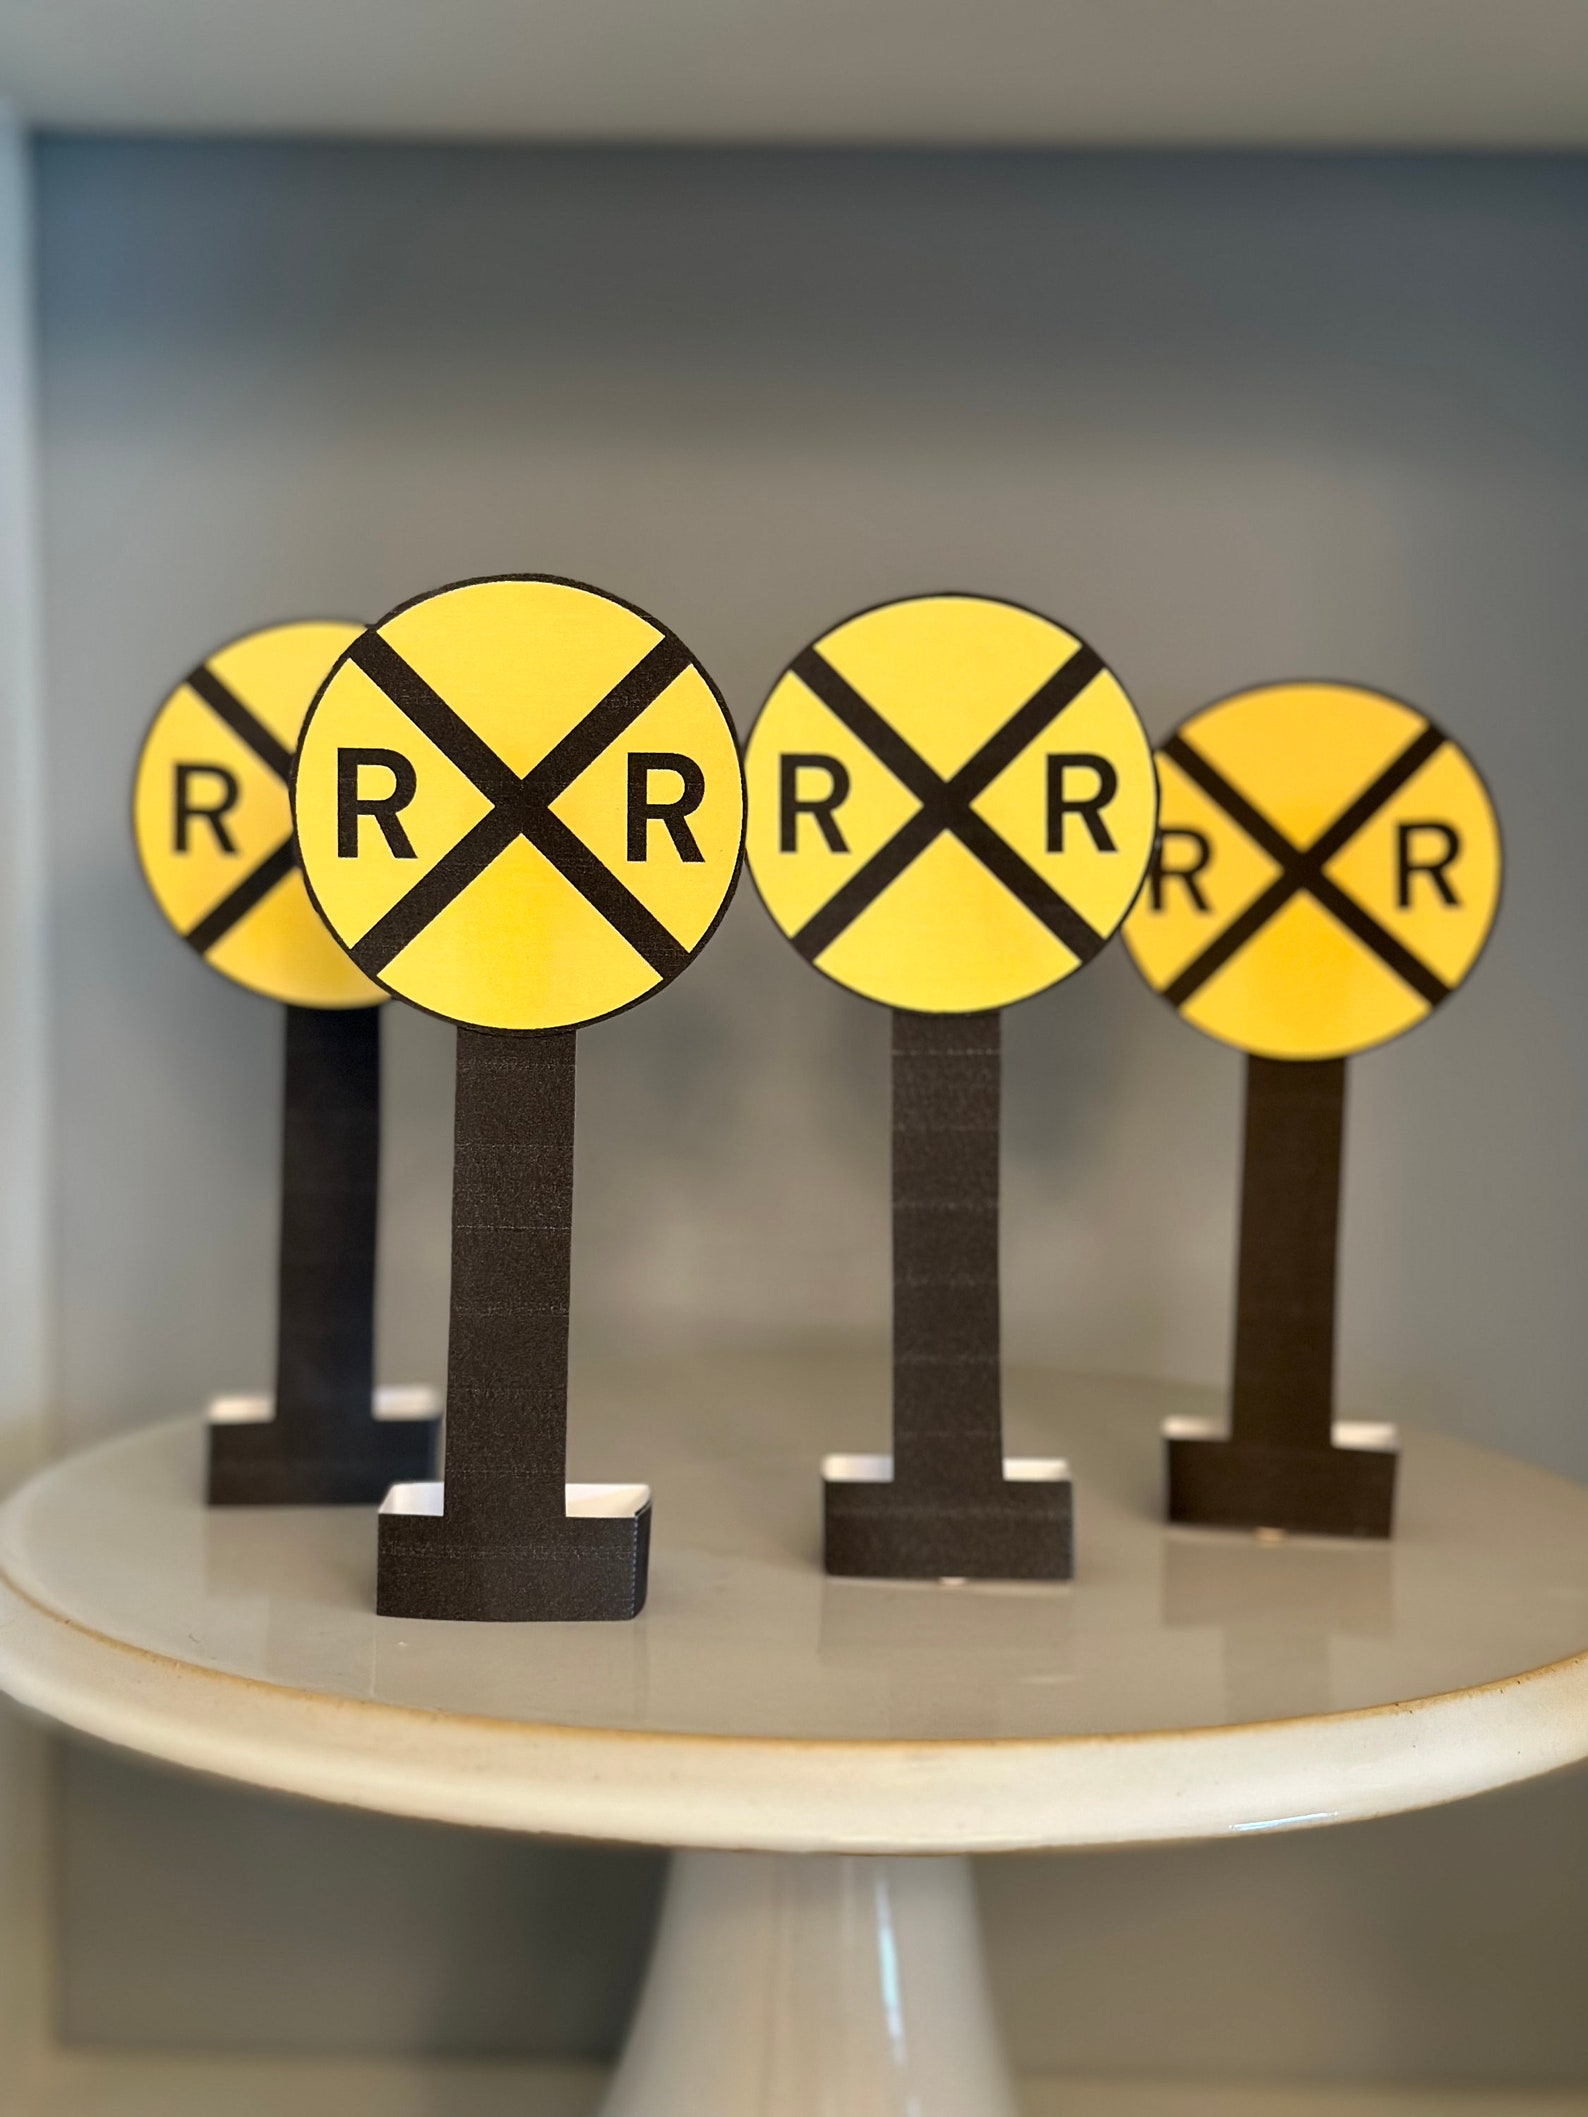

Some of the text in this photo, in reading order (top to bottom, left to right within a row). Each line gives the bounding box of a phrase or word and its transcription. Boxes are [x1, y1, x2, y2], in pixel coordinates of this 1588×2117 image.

[173, 762, 240, 855] R
[337, 747, 706, 863] R R
[779, 753, 1118, 854] R R
[1150, 821, 1461, 911] R R
